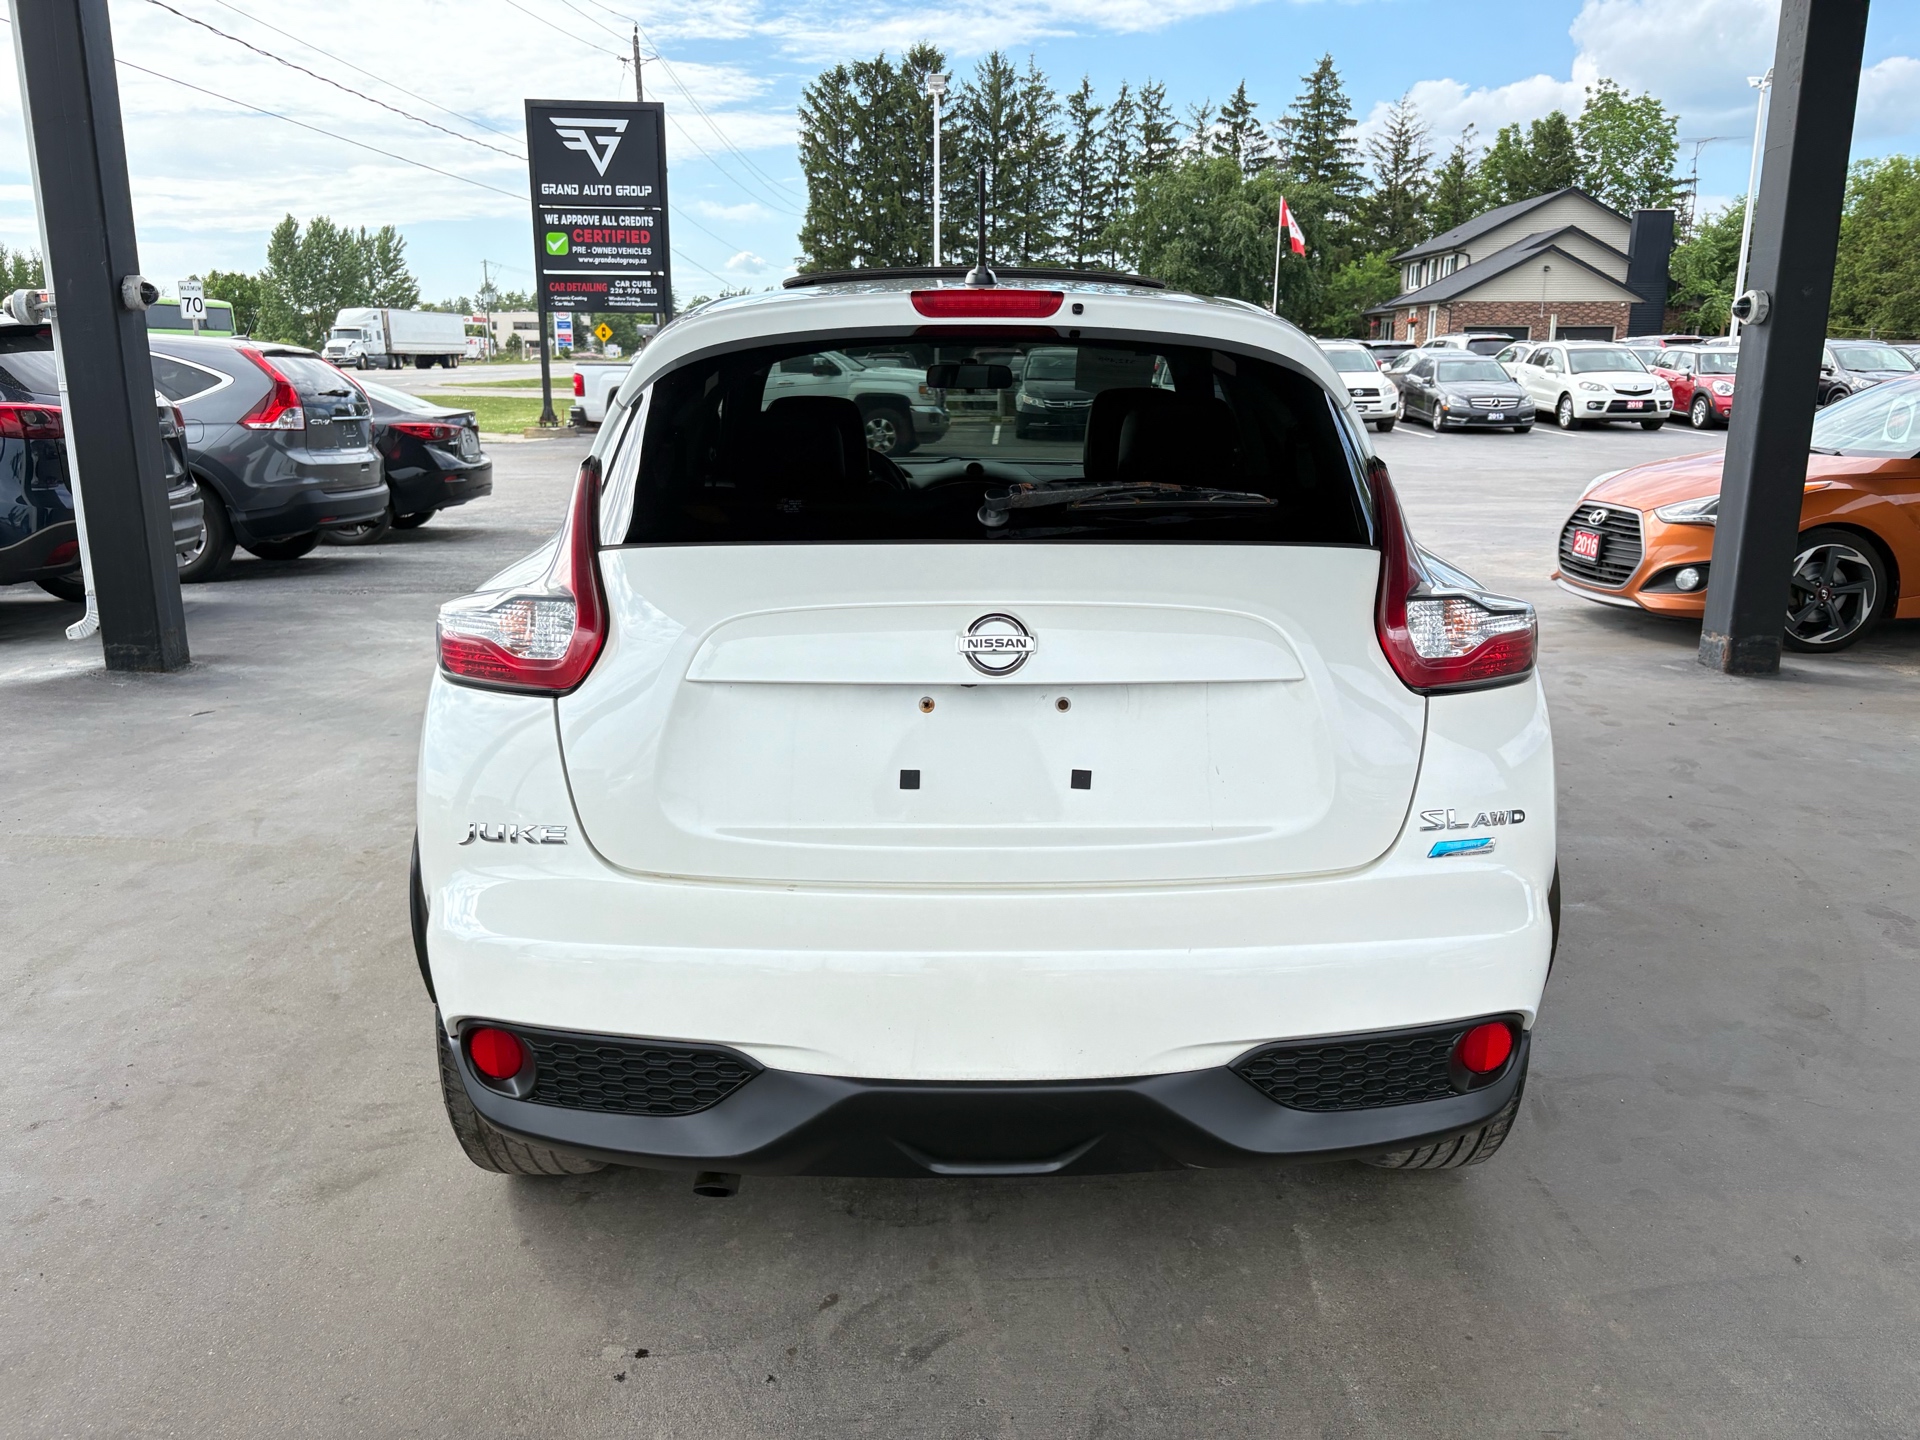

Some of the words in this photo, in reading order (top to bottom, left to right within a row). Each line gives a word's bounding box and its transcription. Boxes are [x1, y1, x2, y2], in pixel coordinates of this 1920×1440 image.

[541, 184, 579, 195] GRAND
[583, 184, 612, 196] AUTO
[615, 185, 652, 197] GROUP
[544, 214, 559, 225] WE
[561, 214, 600, 226] APPROVE
[601, 215, 617, 226] ALL
[618, 216, 654, 227] CREDITS
[572, 229, 651, 244] CERTIFIED
[572, 246, 587, 254] PRE
[591, 246, 617, 255] OWNED
[618, 247, 652, 255] VEHICLES
[578, 256, 648, 265] www.grandautogroup.ca
[549, 282, 565, 292] CAR
[566, 282, 608, 292] DETAILING
[615, 280, 630, 288] CAR
[631, 280, 652, 288] CURE
[182, 297, 203, 313] 70
[1574, 534, 1599, 555] 2016
[967, 638, 1027, 649] NISSAN
[1419, 808, 1469, 832] SL
[1470, 809, 1526, 829] AWD
[456, 822, 568, 846] JUKE
